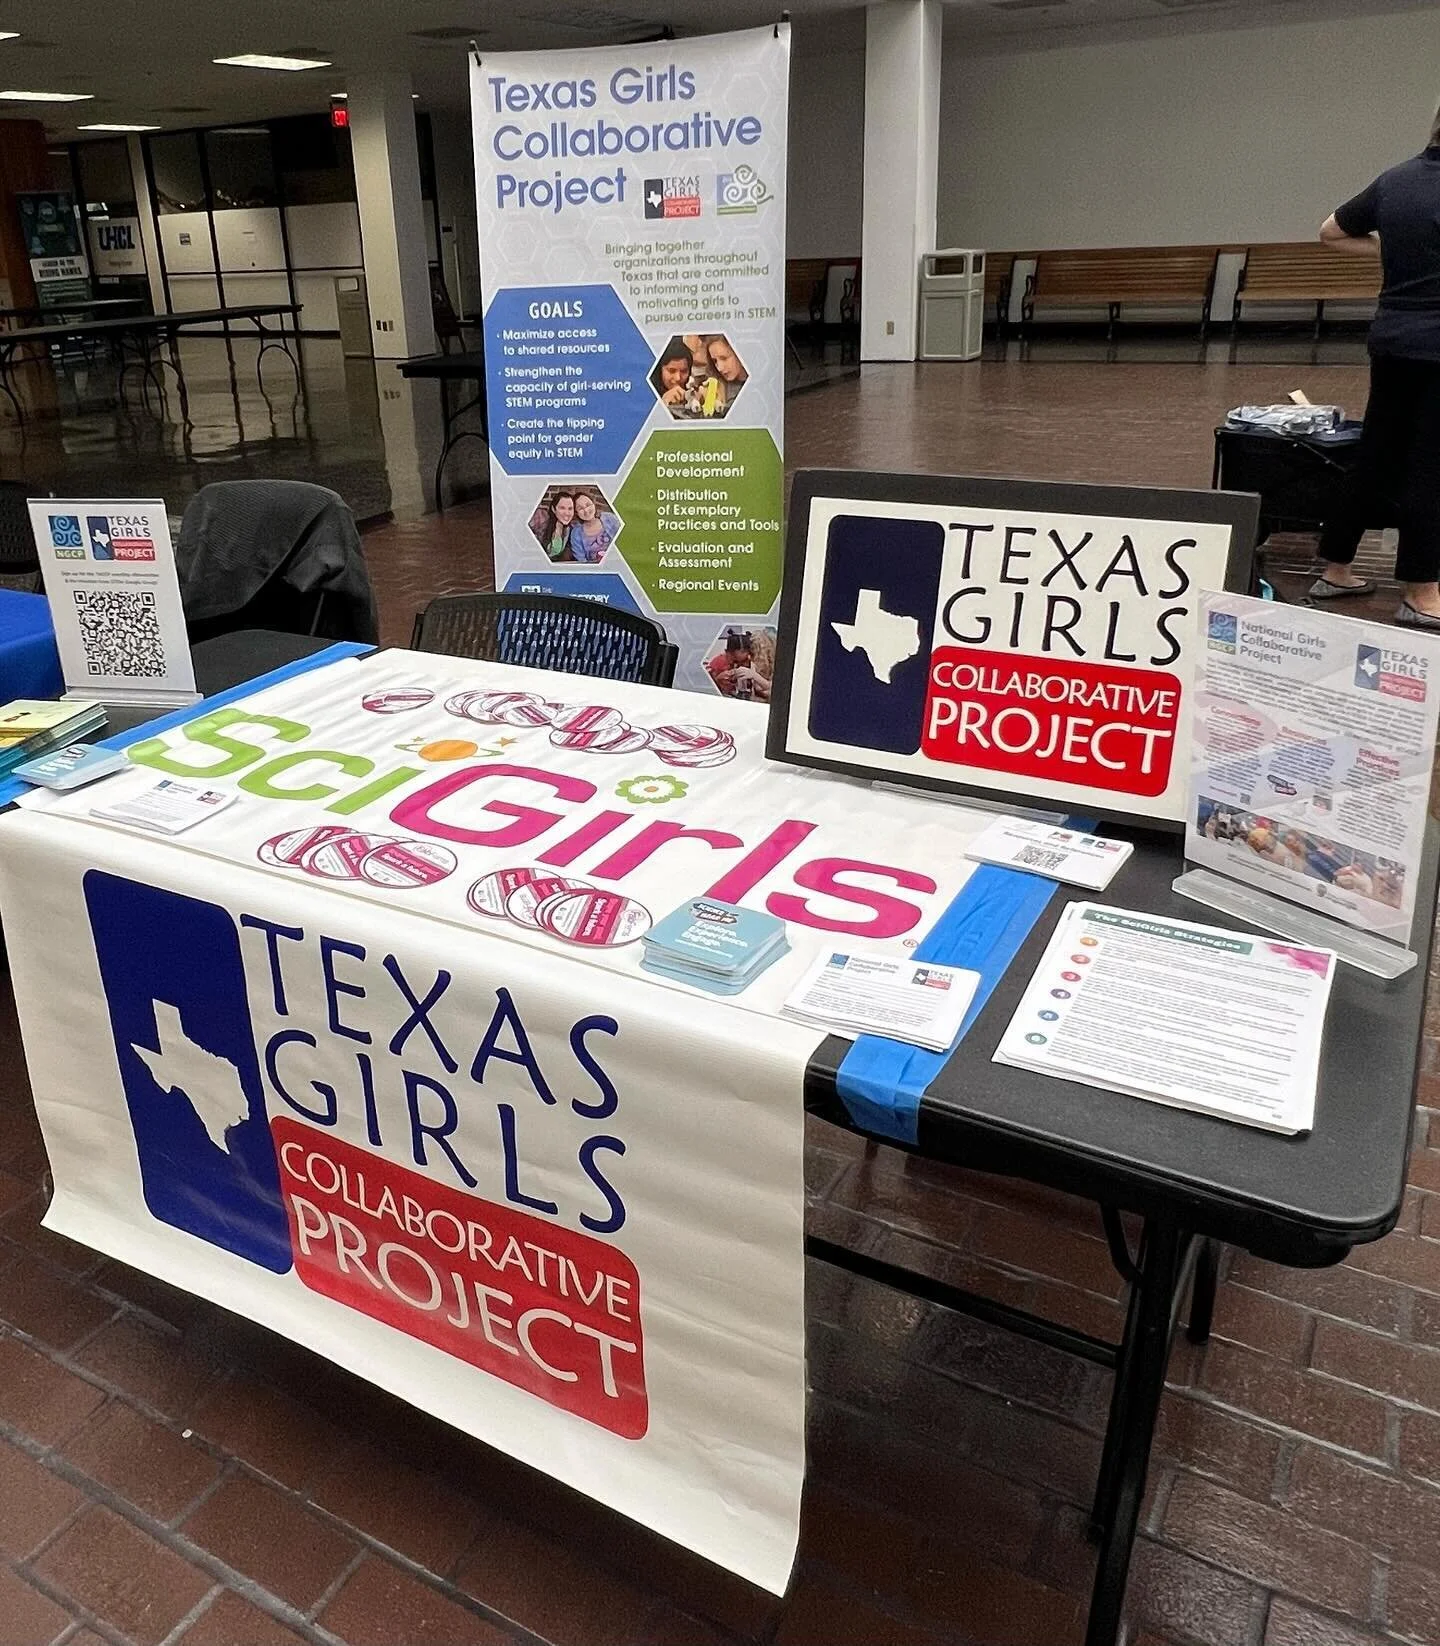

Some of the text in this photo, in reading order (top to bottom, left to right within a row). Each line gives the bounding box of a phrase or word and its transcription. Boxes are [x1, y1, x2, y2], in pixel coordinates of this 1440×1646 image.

[488, 64, 696, 112] Texas Girls
[493, 112, 762, 161] Collaborative
[664, 176, 700, 188] TEXAS
[496, 167, 627, 214] Project
[664, 186, 700, 198] GIRLS
[605, 240, 705, 256] Bringing together
[613, 251, 758, 270] organizations throughout
[621, 264, 769, 282] Texas that are committed
[629, 281, 725, 296] to informing and
[637, 295, 739, 309] motivating girls to
[529, 301, 583, 319] GOALS
[645, 307, 776, 324] pursue careers in STEM
[503, 328, 597, 341] Maximize access
[503, 344, 610, 355] to shared resources
[504, 366, 583, 378] Strengthen the
[505, 380, 631, 394] capacity of girl-serving
[505, 397, 587, 408] STEM programs
[507, 418, 605, 430] Create the tipping
[507, 433, 593, 445] point for gender
[508, 447, 583, 460] equity in STEM
[656, 450, 733, 463] Professional
[656, 465, 744, 479] Development
[657, 489, 728, 501] Distribution
[657, 504, 741, 517] of Exemplary
[108, 516, 149, 526] TEXAS
[658, 519, 780, 532] Practices and Tools
[111, 527, 151, 538] GIRLS
[56, 550, 84, 559] NGCP
[114, 548, 154, 558] PROJECT
[658, 541, 754, 554] Evaluation and
[658, 556, 733, 568] Assessment
[948, 523, 1197, 600] TEXAS
[658, 579, 760, 592] Regional Events
[942, 586, 1189, 666] GIRLS
[1241, 621, 1327, 648] National Girls
[1240, 633, 1322, 660] Collaborative
[1239, 646, 1282, 664] Project
[1382, 649, 1429, 668] TEXAS
[1381, 661, 1427, 679] GIRLS
[932, 661, 1176, 719] COLLABORATIVE
[928, 697, 1172, 775] PROJECT
[127, 707, 938, 939] SciGirls
[1095, 912, 1241, 949] The SciGirls Strategies
[240, 913, 619, 1120] TEXAS
[265, 1028, 627, 1235] GIRLS
[280, 1142, 632, 1323] COLLABORATIVE
[290, 1192, 637, 1399] PROJECT
